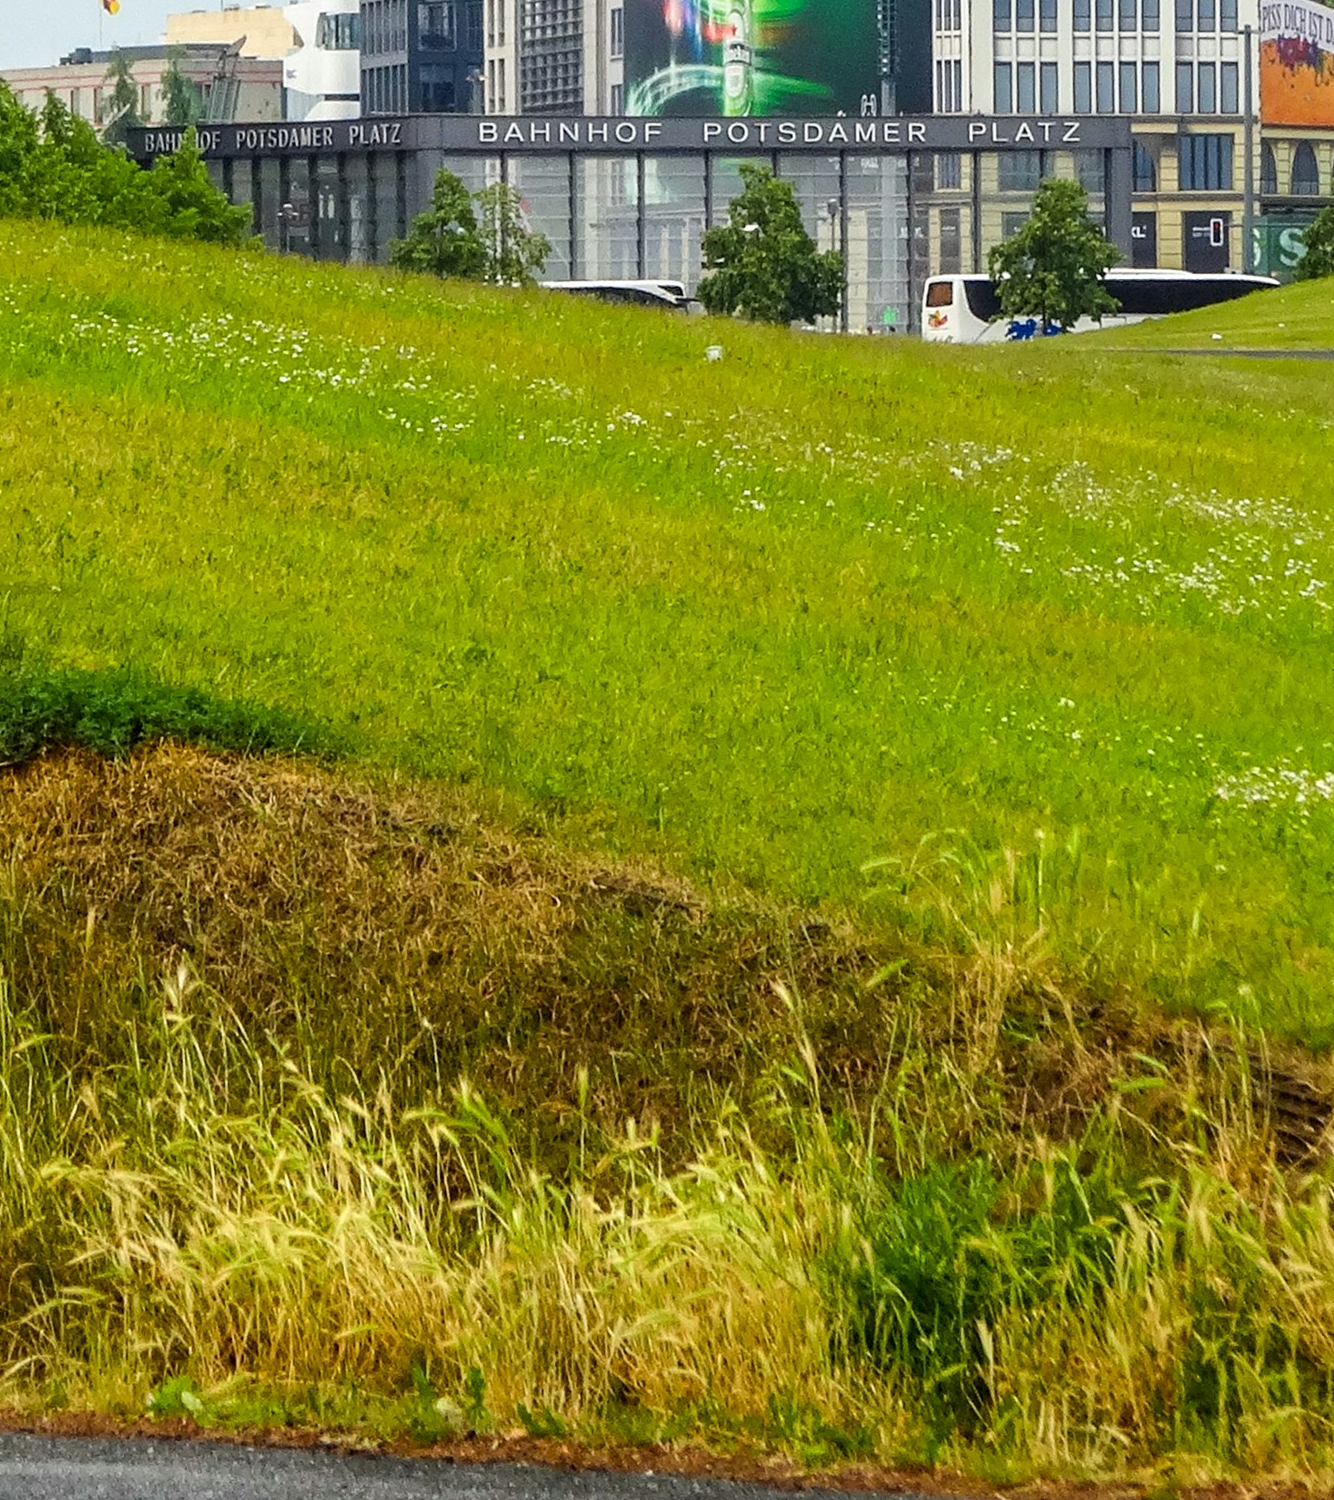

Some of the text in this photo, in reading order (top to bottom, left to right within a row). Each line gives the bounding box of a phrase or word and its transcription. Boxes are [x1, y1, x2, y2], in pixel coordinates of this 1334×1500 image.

[1284, 3, 1307, 33] DICH
[1308, 11, 1323, 41] IST
[236, 126, 333, 150] POTSDAMER
[349, 123, 402, 146] PLATZ
[478, 121, 1081, 143] BAHNHOF POTSDAMER PLATZ
